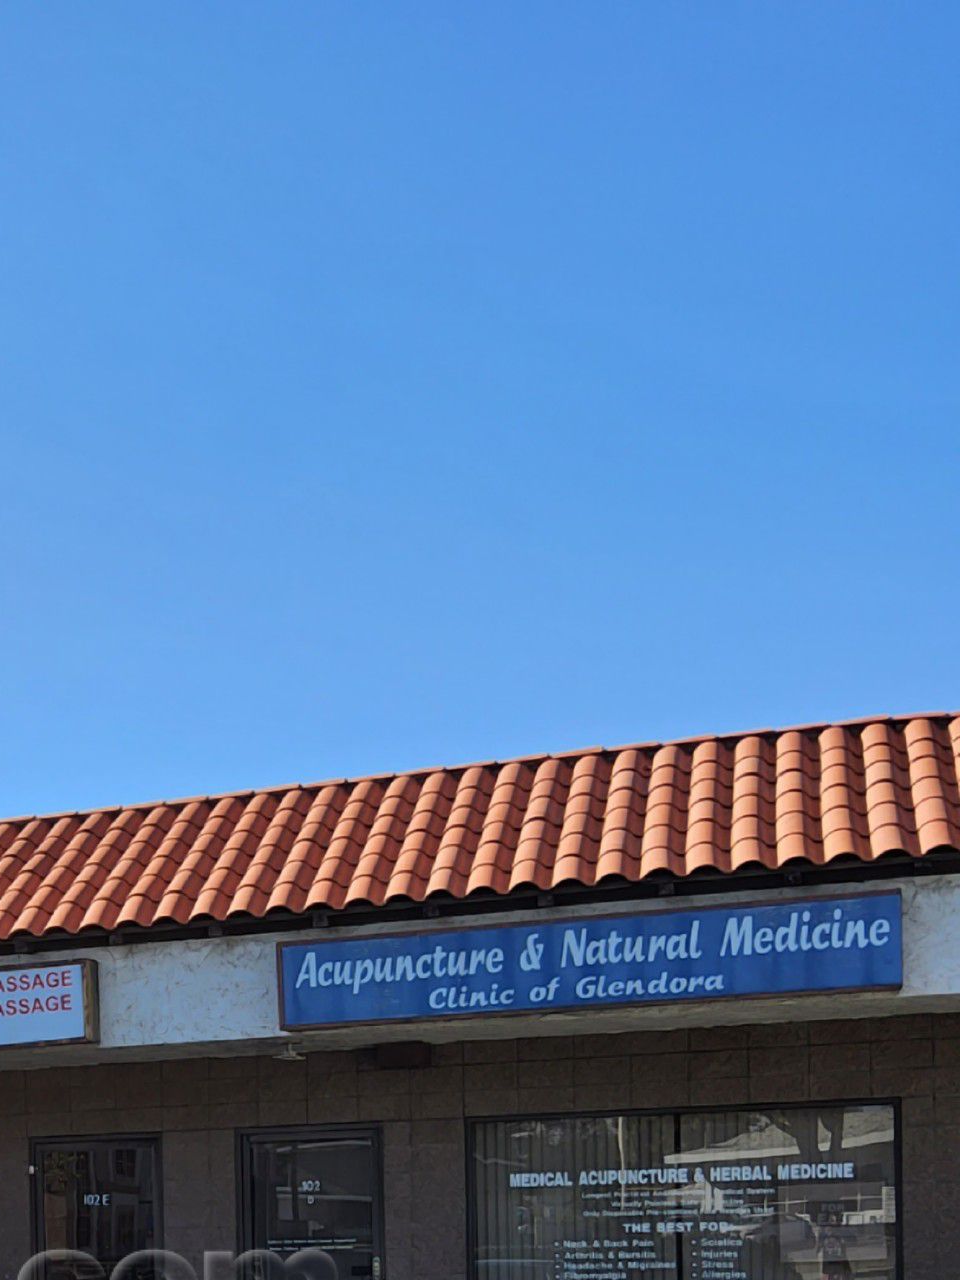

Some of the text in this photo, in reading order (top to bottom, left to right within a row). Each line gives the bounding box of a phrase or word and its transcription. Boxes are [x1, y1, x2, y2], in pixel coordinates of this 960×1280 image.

[295, 908, 890, 994] Acupuncture & Natural Medicine
[428, 971, 725, 1010] Clinic of Glendora
[509, 1162, 855, 1188] MEDICAL ACUPUNCTURE & HERBAL MEDICINE
[83, 1193, 111, 1206] 102 E
[623, 1222, 651, 1233] THE
[656, 1221, 694, 1233] BEST
